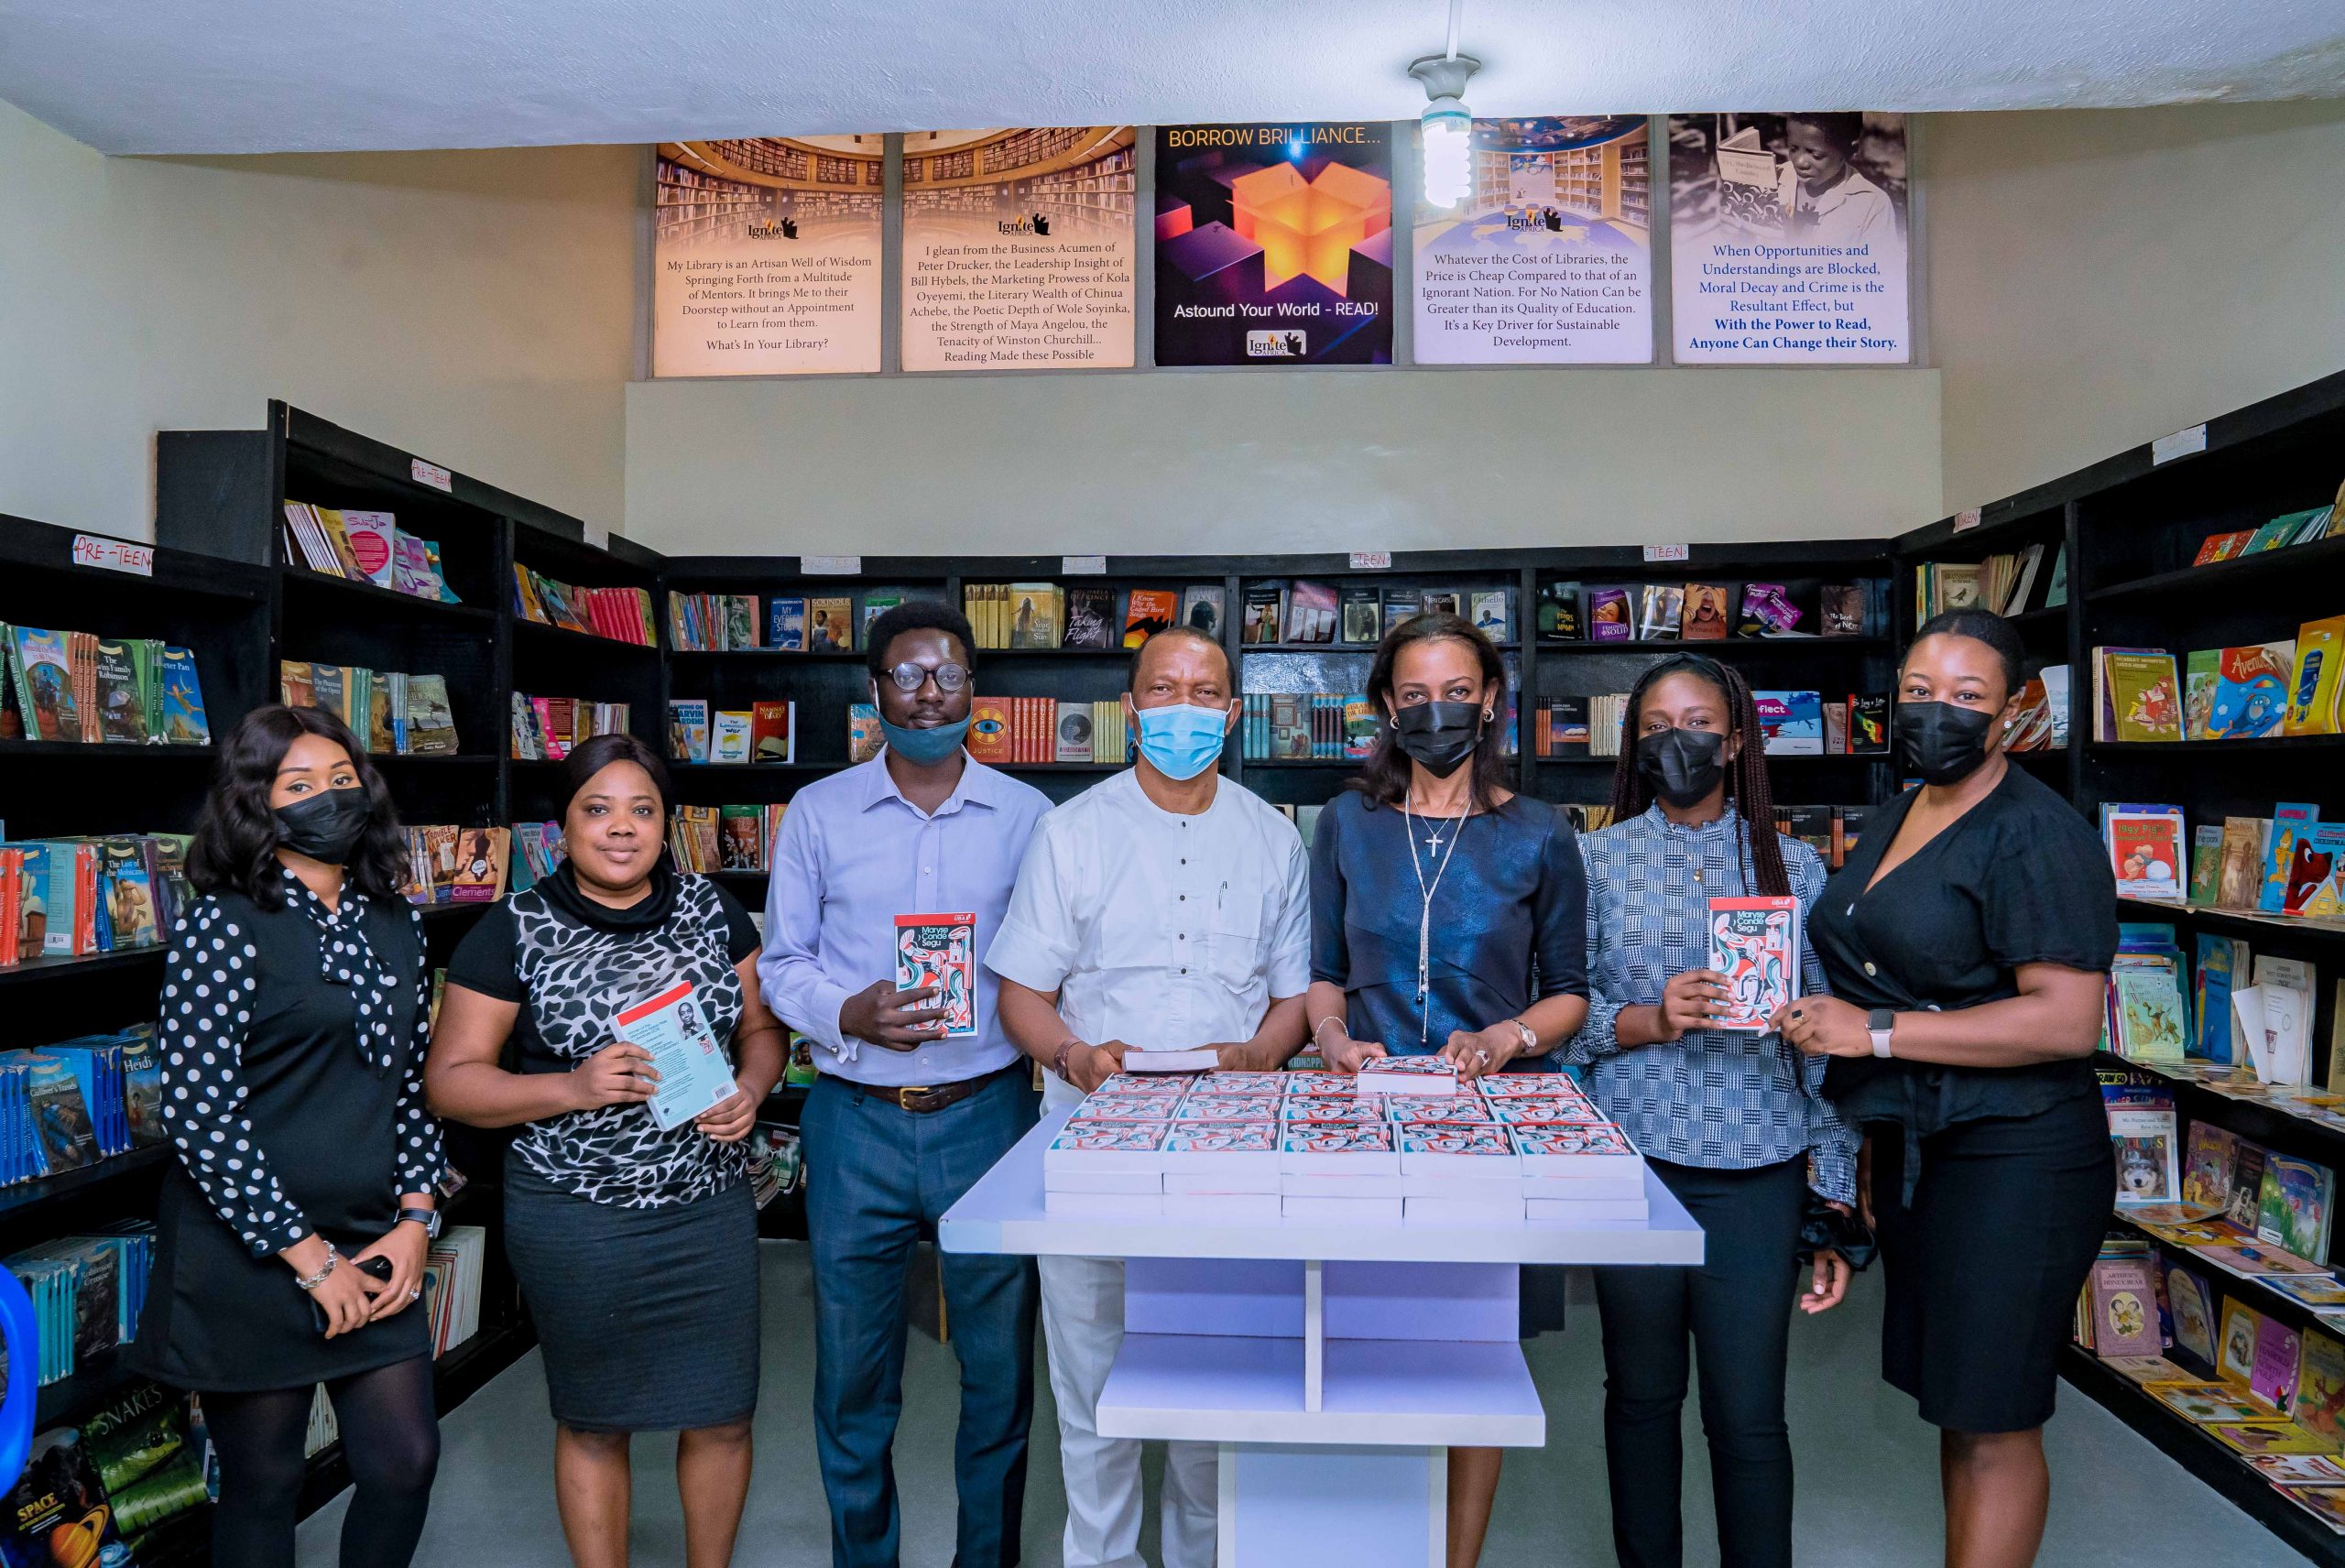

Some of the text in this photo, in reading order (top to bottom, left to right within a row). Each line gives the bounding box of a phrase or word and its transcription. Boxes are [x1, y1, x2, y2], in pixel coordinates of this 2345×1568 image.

[1170, 128, 1253, 147] BORROW
[1508, 215, 1544, 230] Ignite
[747, 220, 782, 239] Ignite
[1713, 244, 1869, 259] When Opportunities and
[668, 261, 683, 273] My
[686, 260, 723, 272] Library
[725, 260, 733, 268] is
[751, 259, 788, 268] Artisan
[791, 257, 813, 267] Well
[816, 256, 827, 267] of
[830, 256, 871, 267] Wisdom
[1434, 253, 1629, 265] Whatever the Cost of Libraries, the
[1426, 271, 1454, 281] Price
[1457, 271, 1466, 280] is
[1469, 270, 1505, 284] Cheap
[1508, 269, 1566, 283] Compared
[1570, 272, 1581, 280] to
[1585, 269, 1606, 280] that
[1609, 269, 1621, 280] of
[1703, 263, 1801, 278] Understandings
[1828, 262, 1880, 275] Blocked,
[685, 276, 734, 288] Springing
[736, 274, 763, 283] Forth
[767, 273, 791, 283] from
[802, 271, 852, 282] Multitude
[689, 289, 700, 299] of
[702, 290, 745, 299] Mentors.
[748, 289, 755, 298] It
[758, 289, 790, 300] brings
[793, 288, 809, 297] Me
[824, 287, 849, 297] their
[1423, 287, 1641, 300] Ignorant Nation. For No Nation Can be
[1700, 280, 1884, 297] Moral Decay and Crime is the
[682, 306, 728, 317] Doorstep
[731, 303, 769, 313] without
[788, 303, 854, 315] Appointment
[1173, 303, 1235, 318] Astound
[1238, 303, 1273, 317] Your
[1277, 302, 1320, 316] World
[1336, 302, 1378, 315] READ!
[1427, 302, 1636, 317] Greater than its Quality of Education.
[1730, 299, 1854, 312] Resultant Effect, but
[730, 320, 758, 329] Learn
[762, 318, 786, 328] from
[790, 318, 818, 327] them.
[1473, 320, 1494, 333] Key
[1498, 320, 1533, 330] Driver
[1537, 319, 1554, 330] for
[1556, 319, 1620, 330] Sustainable
[1715, 318, 1871, 331] With the Power to Read,
[744, 340, 754, 349] In
[758, 340, 782, 349] Your
[785, 338, 828, 351] Library?
[1249, 340, 1286, 354] Ignite
[1494, 335, 1571, 349] Development.
[1689, 336, 1897, 352] Anyone Can Change their Story.
[1648, 545, 1684, 558] TEEN
[1355, 553, 1386, 566] TEEN
[1474, 595, 1503, 604] Othello
[1070, 615, 1103, 628] Taking
[1842, 621, 1859, 630] NOT
[1064, 628, 1100, 644] Flight
[104, 656, 117, 664] The
[178, 662, 190, 670] Pan
[98, 670, 128, 681] Robinson
[110, 665, 131, 676] Family
[428, 833, 457, 852] MAKER
[108, 860, 120, 868] The
[453, 887, 496, 897] Clements
[1737, 925, 1757, 933] Segu
[922, 940, 941, 948] Segu
[124, 1056, 152, 1073] Heidi
[2100, 1074, 2114, 1083] RAW
[58, 1082, 78, 1092] Travels
[2115, 1138, 2164, 1149] WOLVES
[81, 1261, 114, 1279] Robinson
[84, 1271, 110, 1287] Crusoe
[98, 1383, 163, 1436] SNAKES
[16, 1492, 57, 1523] SPACE
